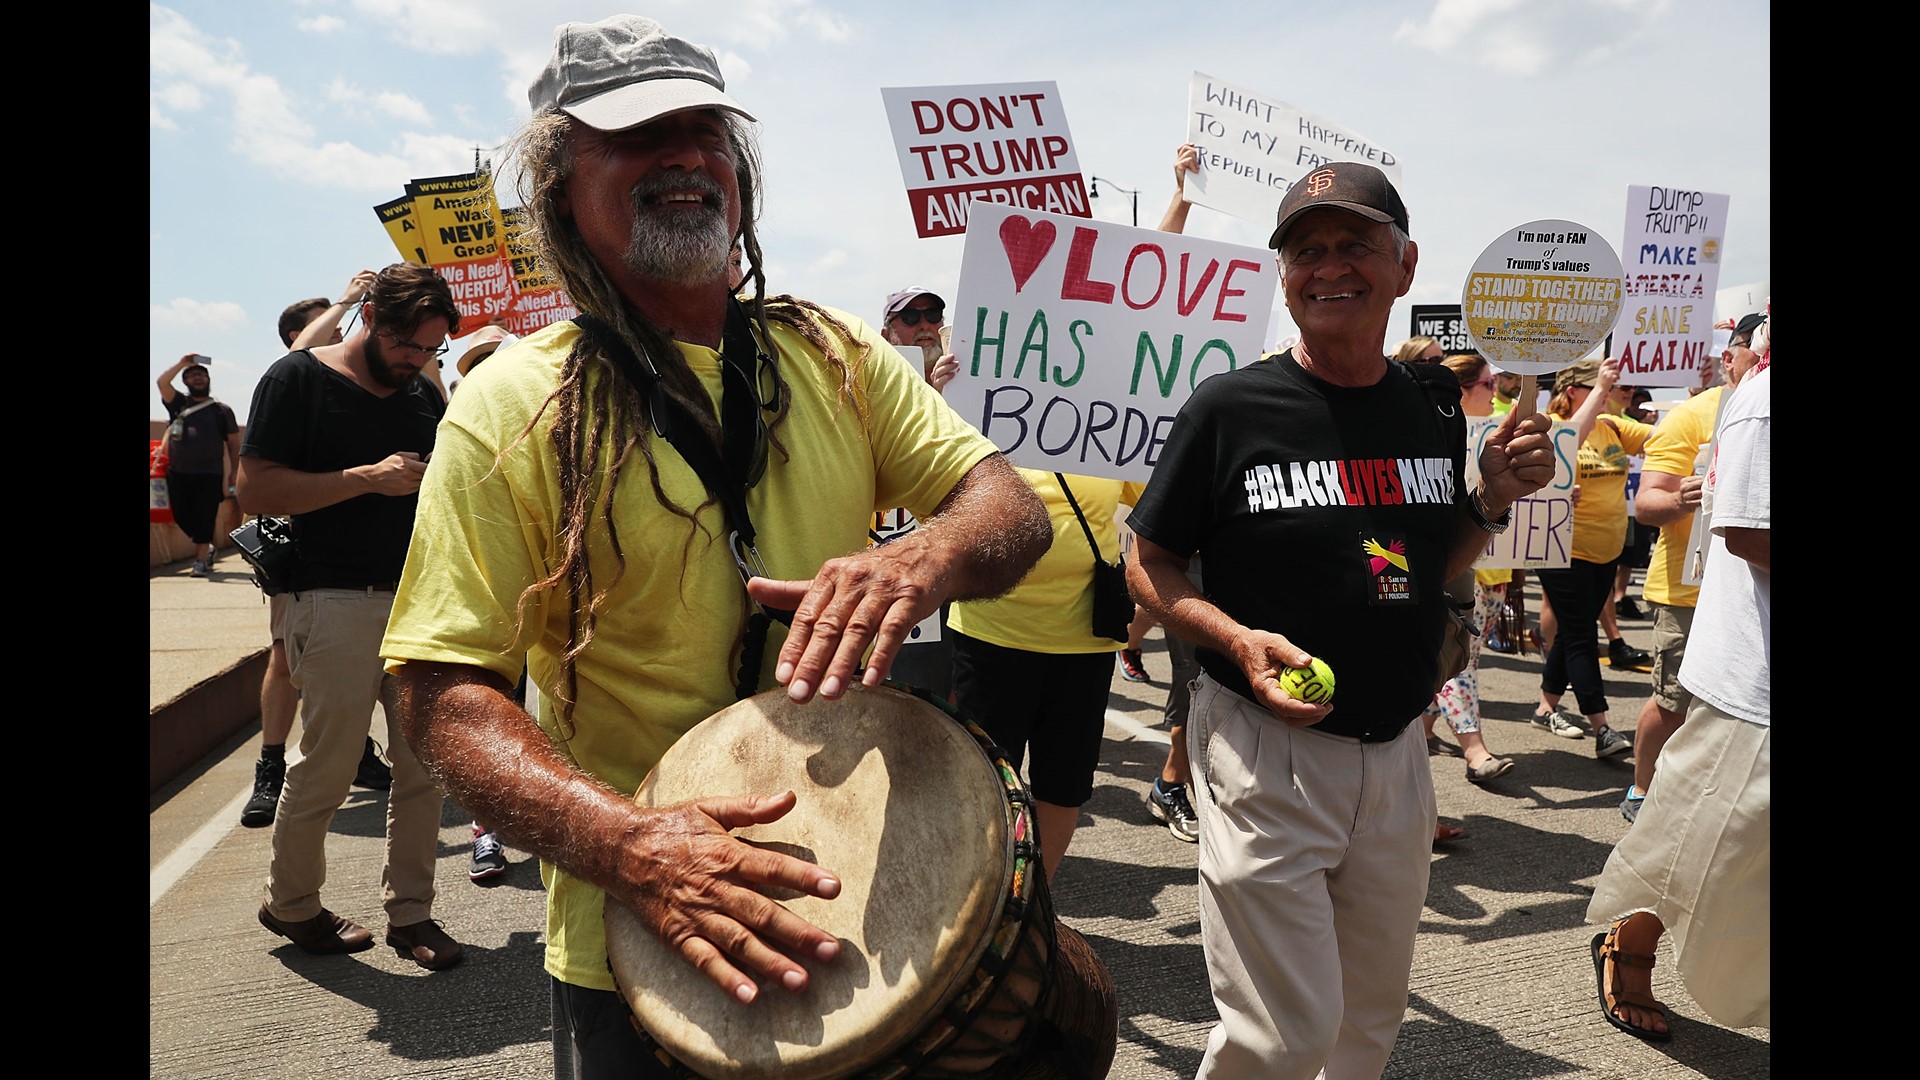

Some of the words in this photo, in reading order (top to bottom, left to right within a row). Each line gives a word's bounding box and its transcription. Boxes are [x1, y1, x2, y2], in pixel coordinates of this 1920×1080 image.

[911, 93, 1046, 135] DON'T
[1206, 83, 1280, 123] WHAT
[1299, 117, 1396, 167] HAPPENED
[1195, 111, 1225, 138] TO
[1242, 129, 1279, 155] MY
[910, 135, 1069, 181] TRUMP
[1517, 231, 1535, 243] I'm
[1536, 232, 1556, 243] not
[1557, 234, 1564, 244] a
[1566, 232, 1587, 244] FAN
[1506, 258, 1550, 272] Trump's
[1552, 260, 1590, 272] values
[1543, 247, 1558, 259] of
[1640, 243, 1697, 266] MAKE
[441, 266, 464, 283] We
[1061, 226, 1261, 323] LOVE
[1626, 273, 1703, 299] AMERICA
[1472, 277, 1526, 298] STAND
[1531, 279, 1617, 302] TOGETHER
[1471, 300, 1543, 321] AGAINST
[1546, 302, 1609, 324] TRUMP
[1634, 305, 1693, 335] SANE
[1419, 320, 1445, 335] WE
[970, 306, 1094, 388] HAS
[1129, 331, 1237, 399] NO
